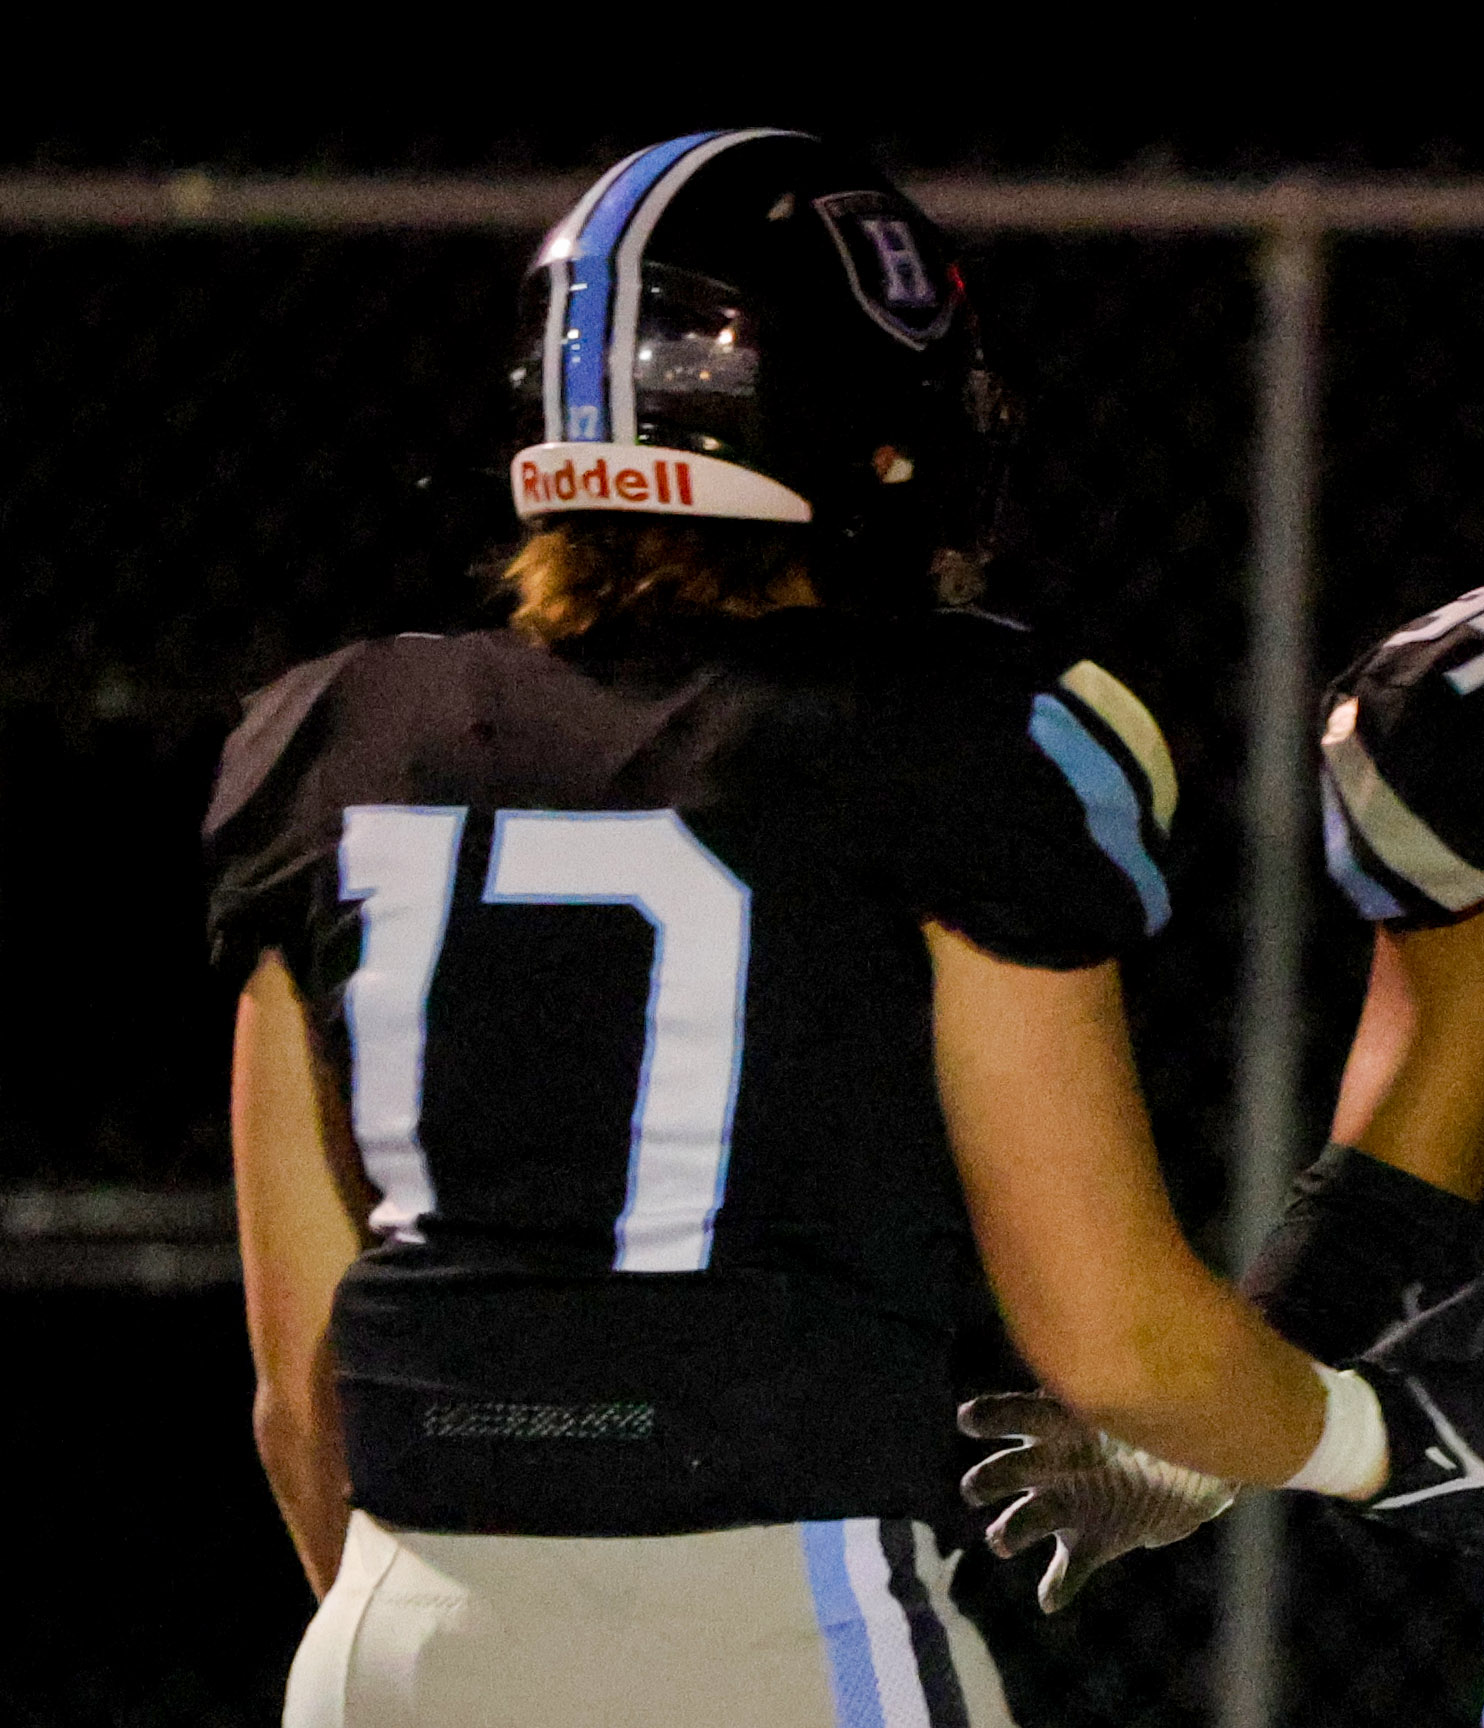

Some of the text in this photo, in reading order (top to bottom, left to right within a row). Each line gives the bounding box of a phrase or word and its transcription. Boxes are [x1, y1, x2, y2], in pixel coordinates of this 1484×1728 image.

[861, 217, 936, 302] H
[519, 459, 692, 505] Riddell
[338, 806, 752, 1272] 17
